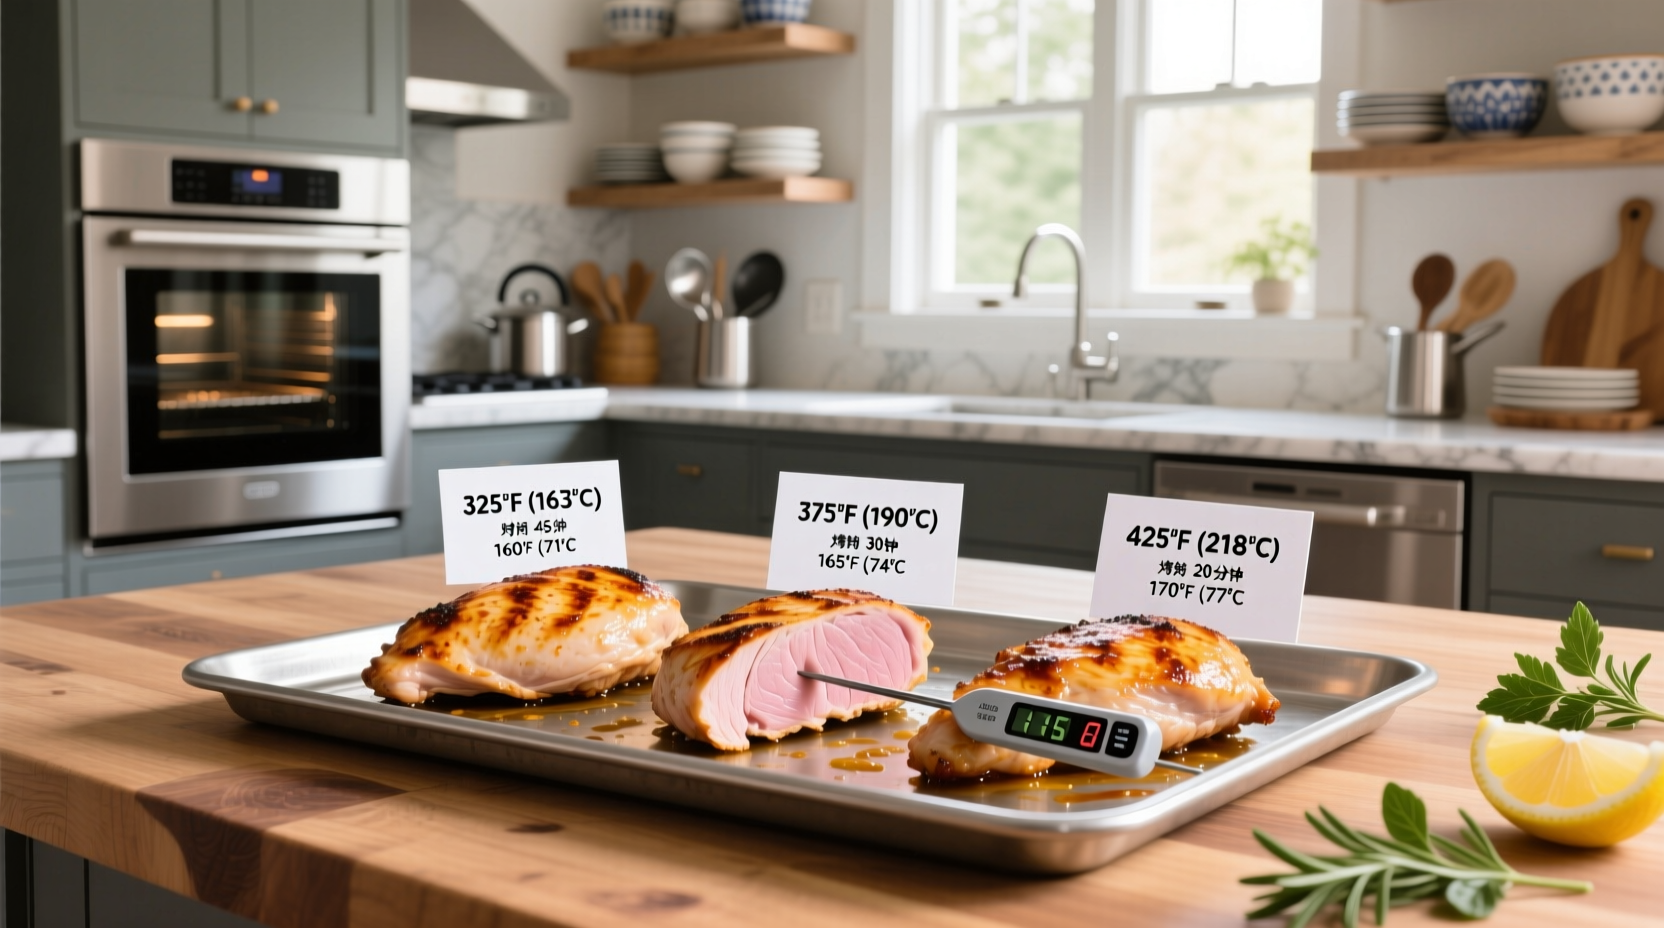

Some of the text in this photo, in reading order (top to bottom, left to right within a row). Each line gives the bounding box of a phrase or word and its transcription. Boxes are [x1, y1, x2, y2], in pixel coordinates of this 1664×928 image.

[463, 487, 602, 516] 325°F (163°C)
[798, 501, 858, 524] 375°F
[1126, 525, 1280, 563] 425°F (218°C)
